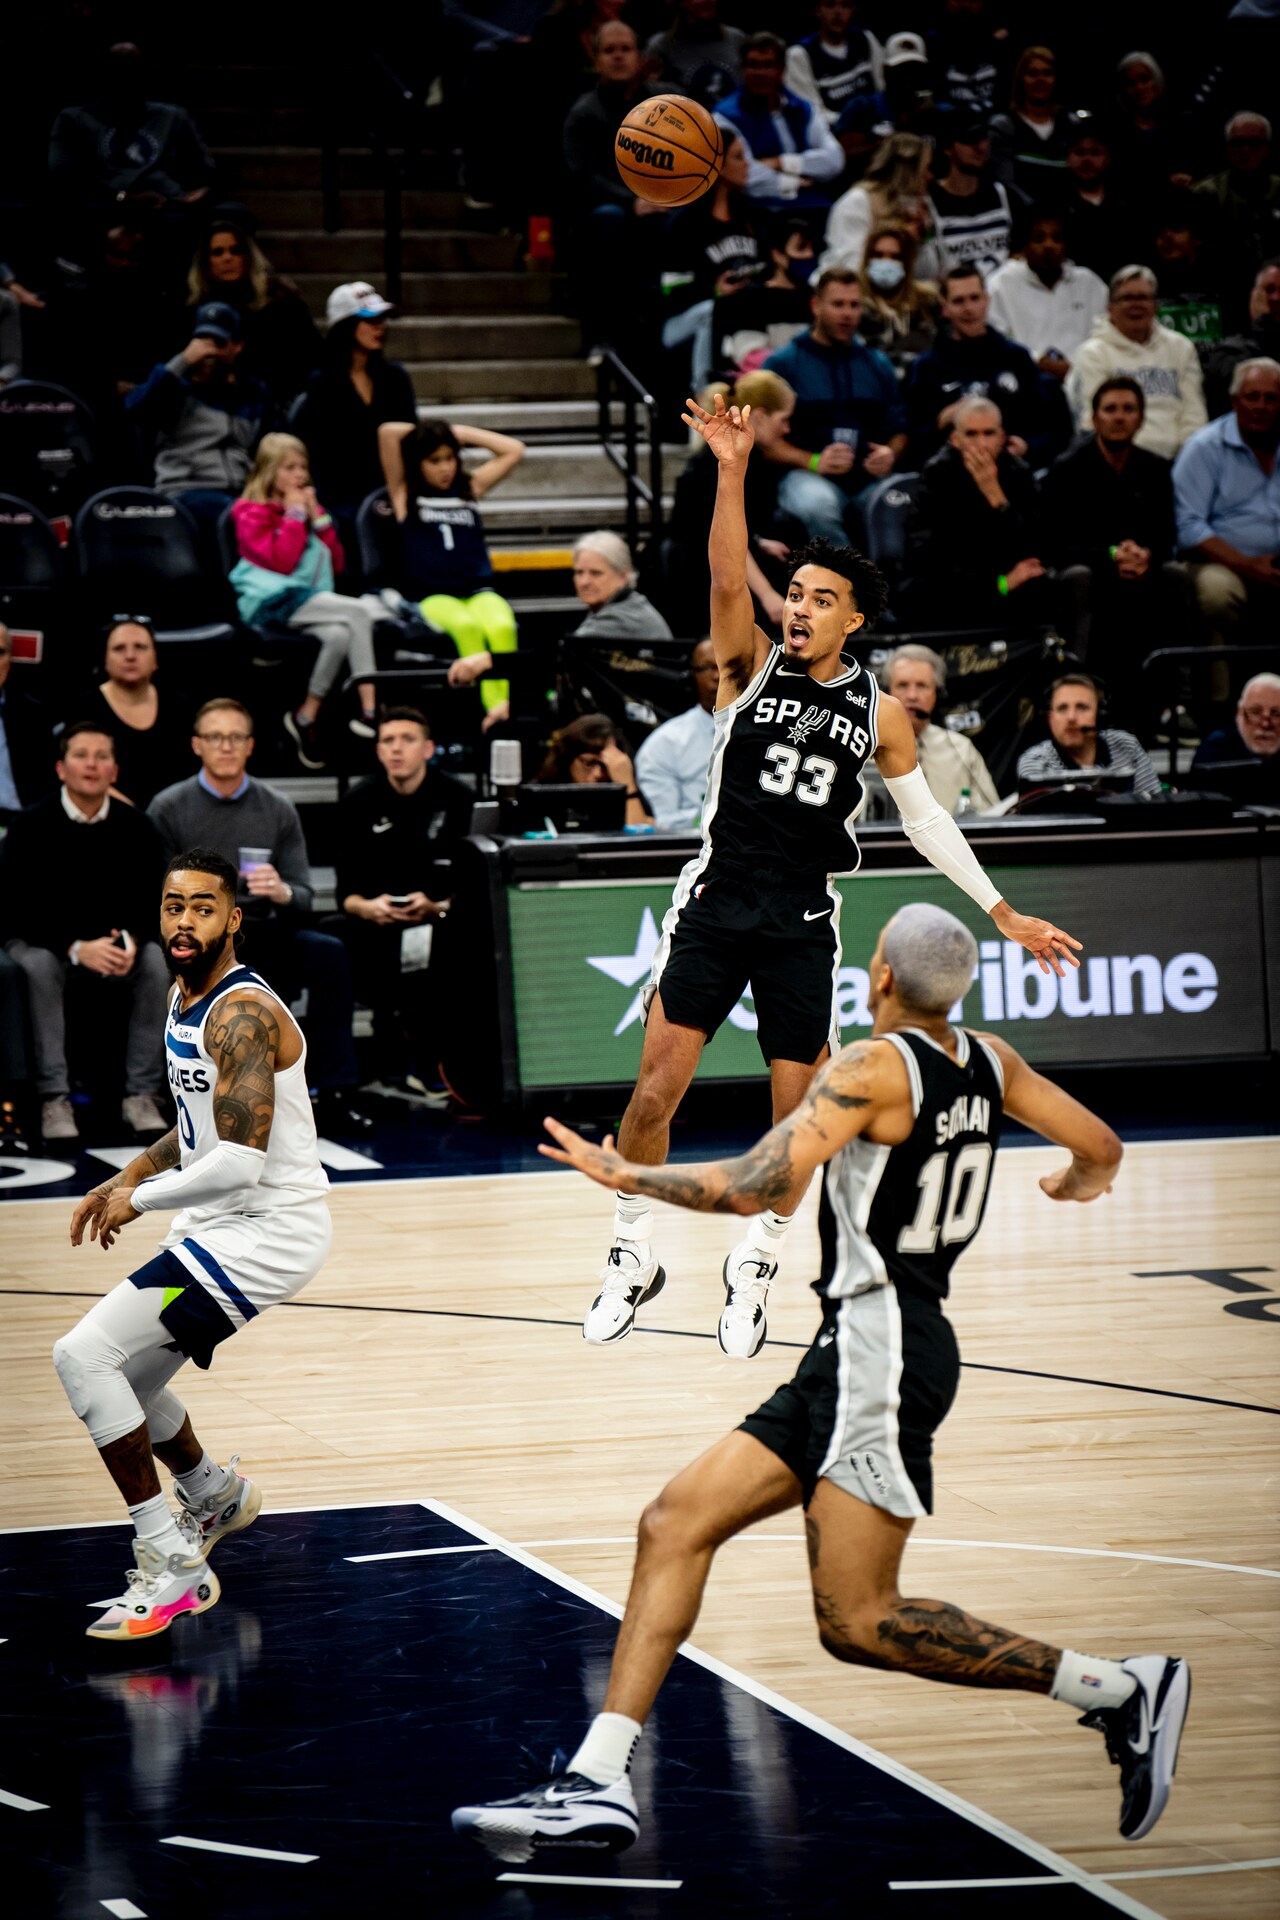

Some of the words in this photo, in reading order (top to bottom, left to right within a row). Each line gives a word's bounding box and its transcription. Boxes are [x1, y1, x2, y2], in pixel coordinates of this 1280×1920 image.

[617, 132, 675, 171] Wilson
[438, 523, 455, 551] 1
[845, 689, 868, 709] Self.
[758, 742, 838, 807] 33
[947, 940, 1219, 1022] ibune
[895, 1141, 993, 1254] 10
